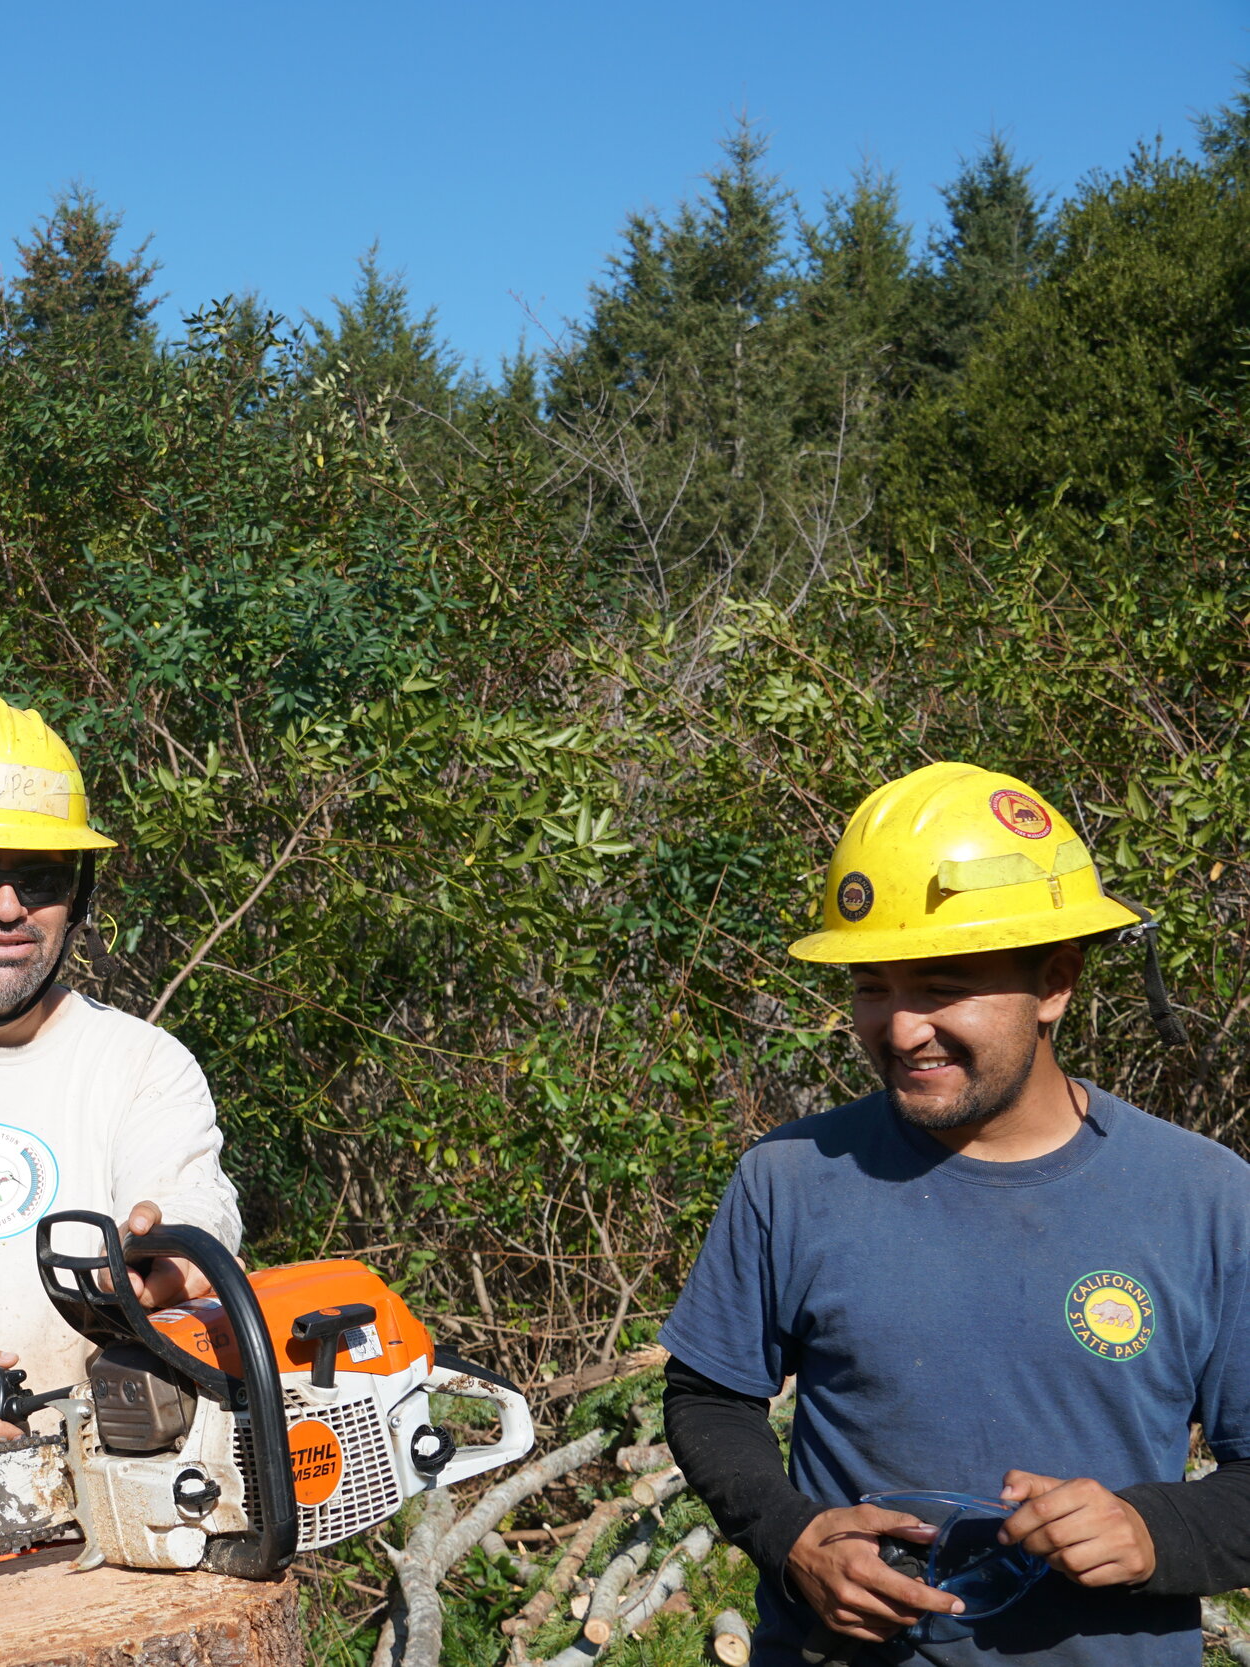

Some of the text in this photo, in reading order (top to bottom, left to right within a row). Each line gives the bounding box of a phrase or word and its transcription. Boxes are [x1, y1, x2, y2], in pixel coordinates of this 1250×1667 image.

[1073, 1274, 1153, 1317] CALIFORNIA
[1070, 1312, 1151, 1358] STATE PARKS
[312, 1461, 336, 1478] 261
